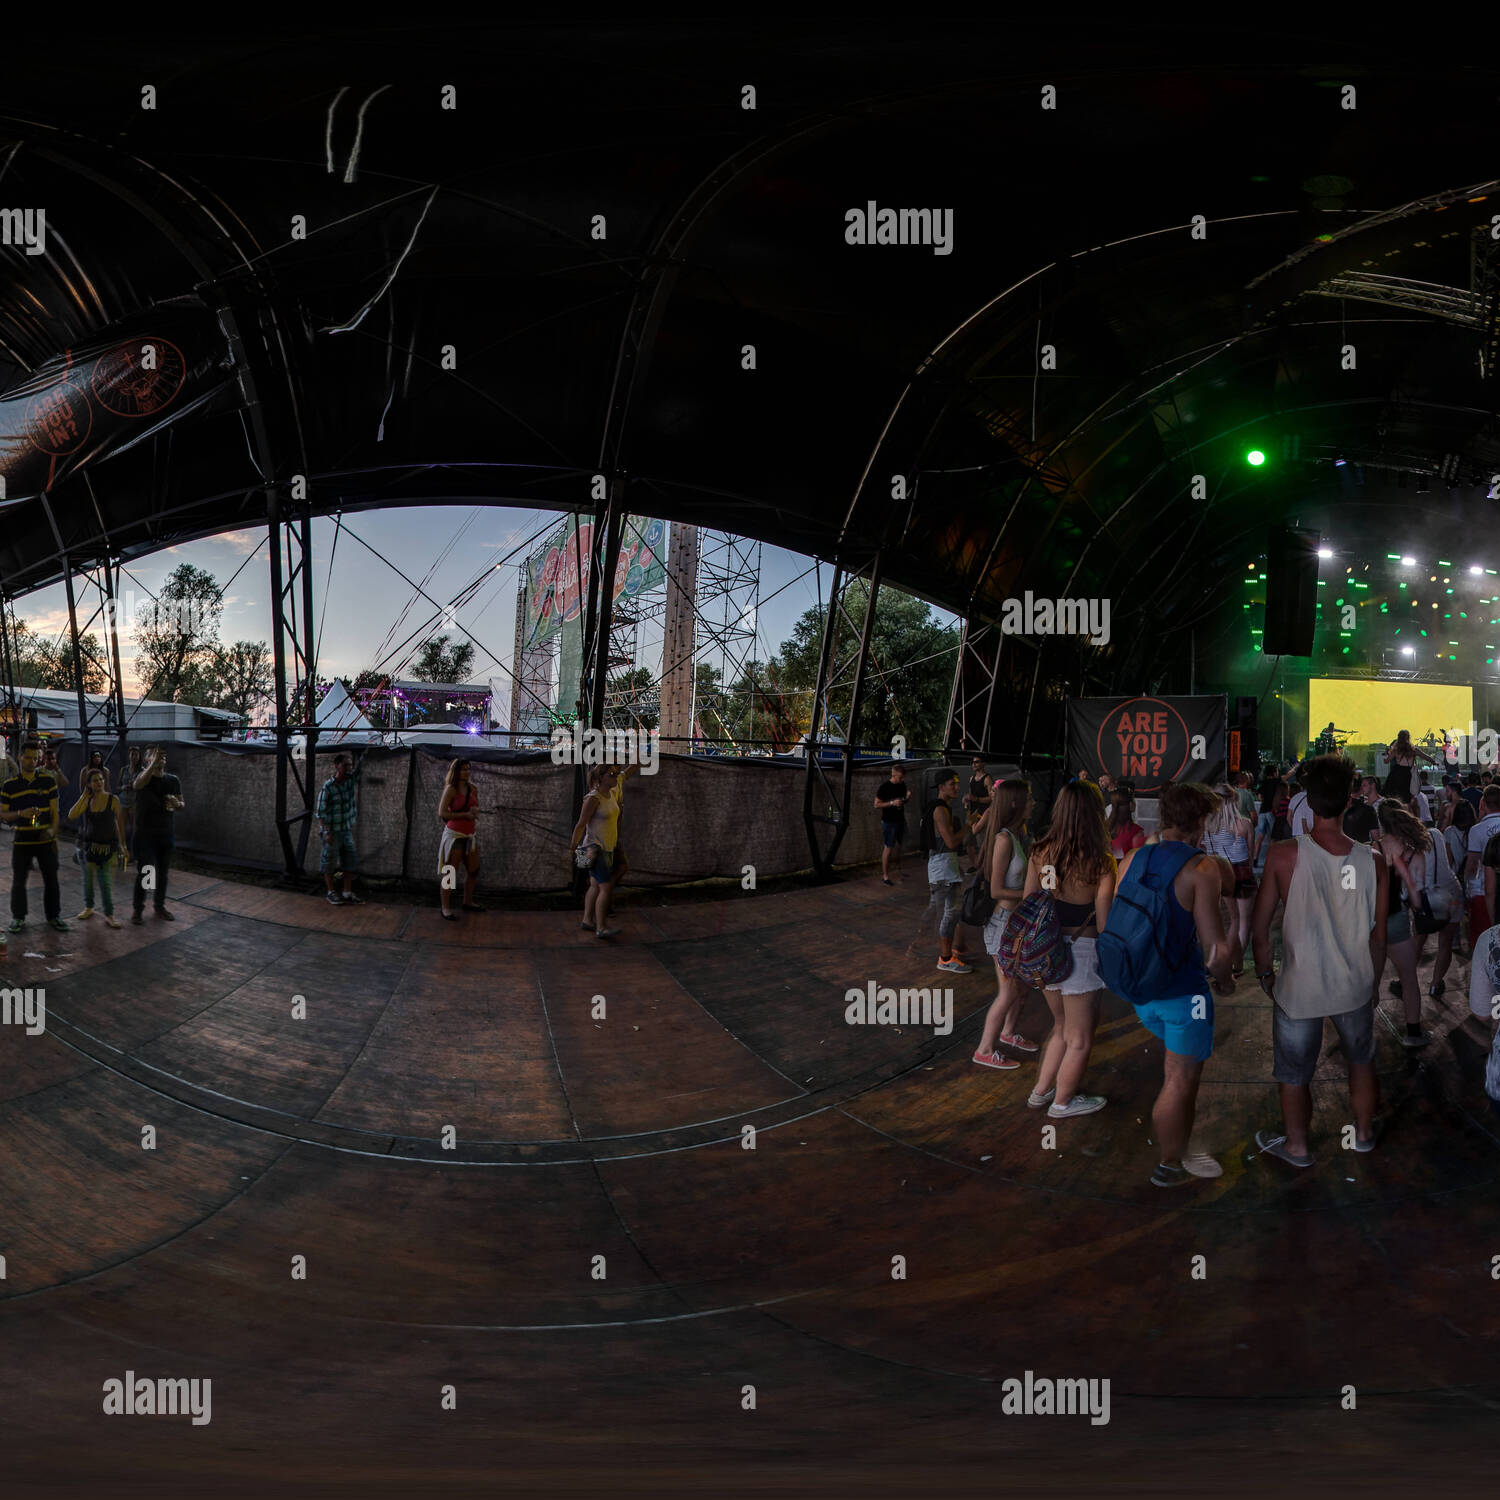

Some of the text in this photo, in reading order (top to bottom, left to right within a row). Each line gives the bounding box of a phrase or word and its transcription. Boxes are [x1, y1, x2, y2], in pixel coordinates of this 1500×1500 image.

[34, 387, 67, 420] ARE
[38, 402, 73, 433] YOU
[48, 420, 79, 449] IN?
[1116, 711, 1169, 733] ARE
[1116, 733, 1168, 755] YOU
[1121, 755, 1163, 777] IN?
